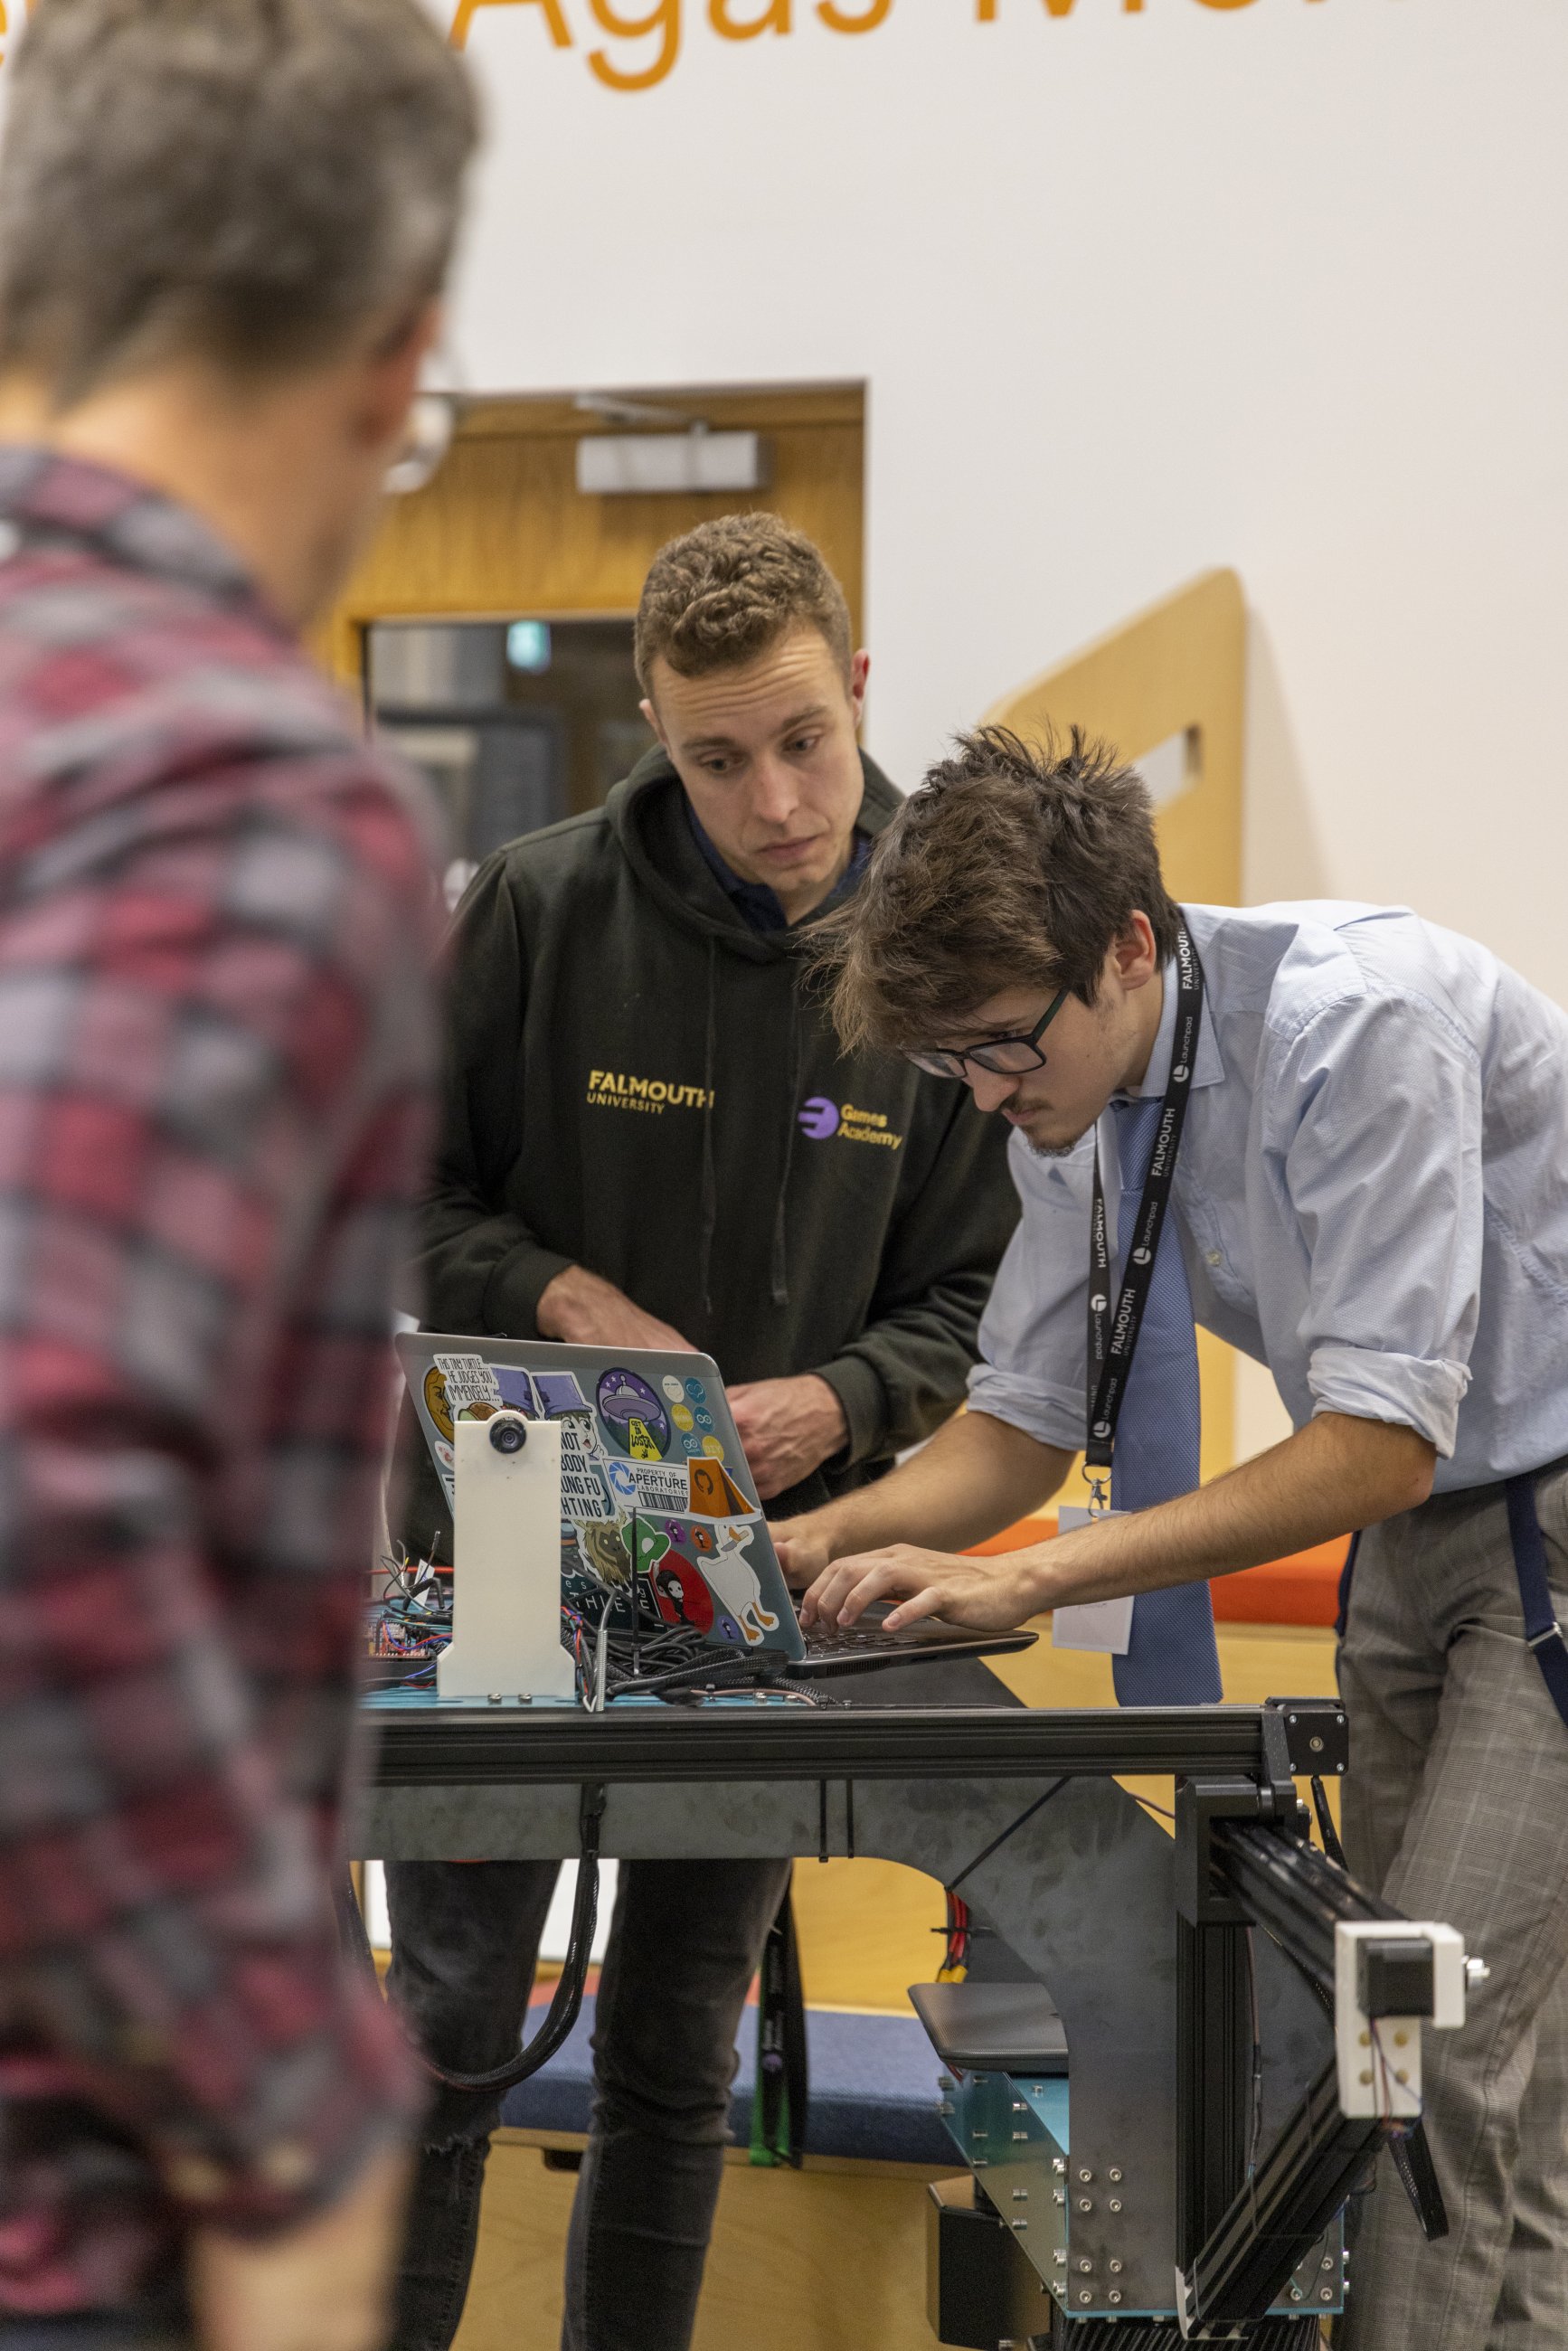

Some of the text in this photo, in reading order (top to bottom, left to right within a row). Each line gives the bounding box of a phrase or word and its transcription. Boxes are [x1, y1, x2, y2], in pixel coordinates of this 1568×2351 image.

[1179, 1016, 1194, 1063] Launchpad
[586, 1091, 665, 1115] UNIVERSITY
[588, 1070, 715, 1109] FALMOUTH
[841, 1104, 887, 1128] Games
[837, 1121, 902, 1150] Academy
[1151, 1109, 1176, 1176] FALMOUTH
[1141, 1201, 1158, 1246] Launchpad
[1110, 1289, 1136, 1355] FALMOUTH
[448, 1371, 458, 1383] HE
[458, 1371, 480, 1383] JUDGES
[1101, 1377, 1118, 1421] Launchpad
[561, 1475, 601, 1496] UNG FU
[628, 1473, 687, 1490] APERTURE
[636, 1468, 666, 1477] PROPERTY
